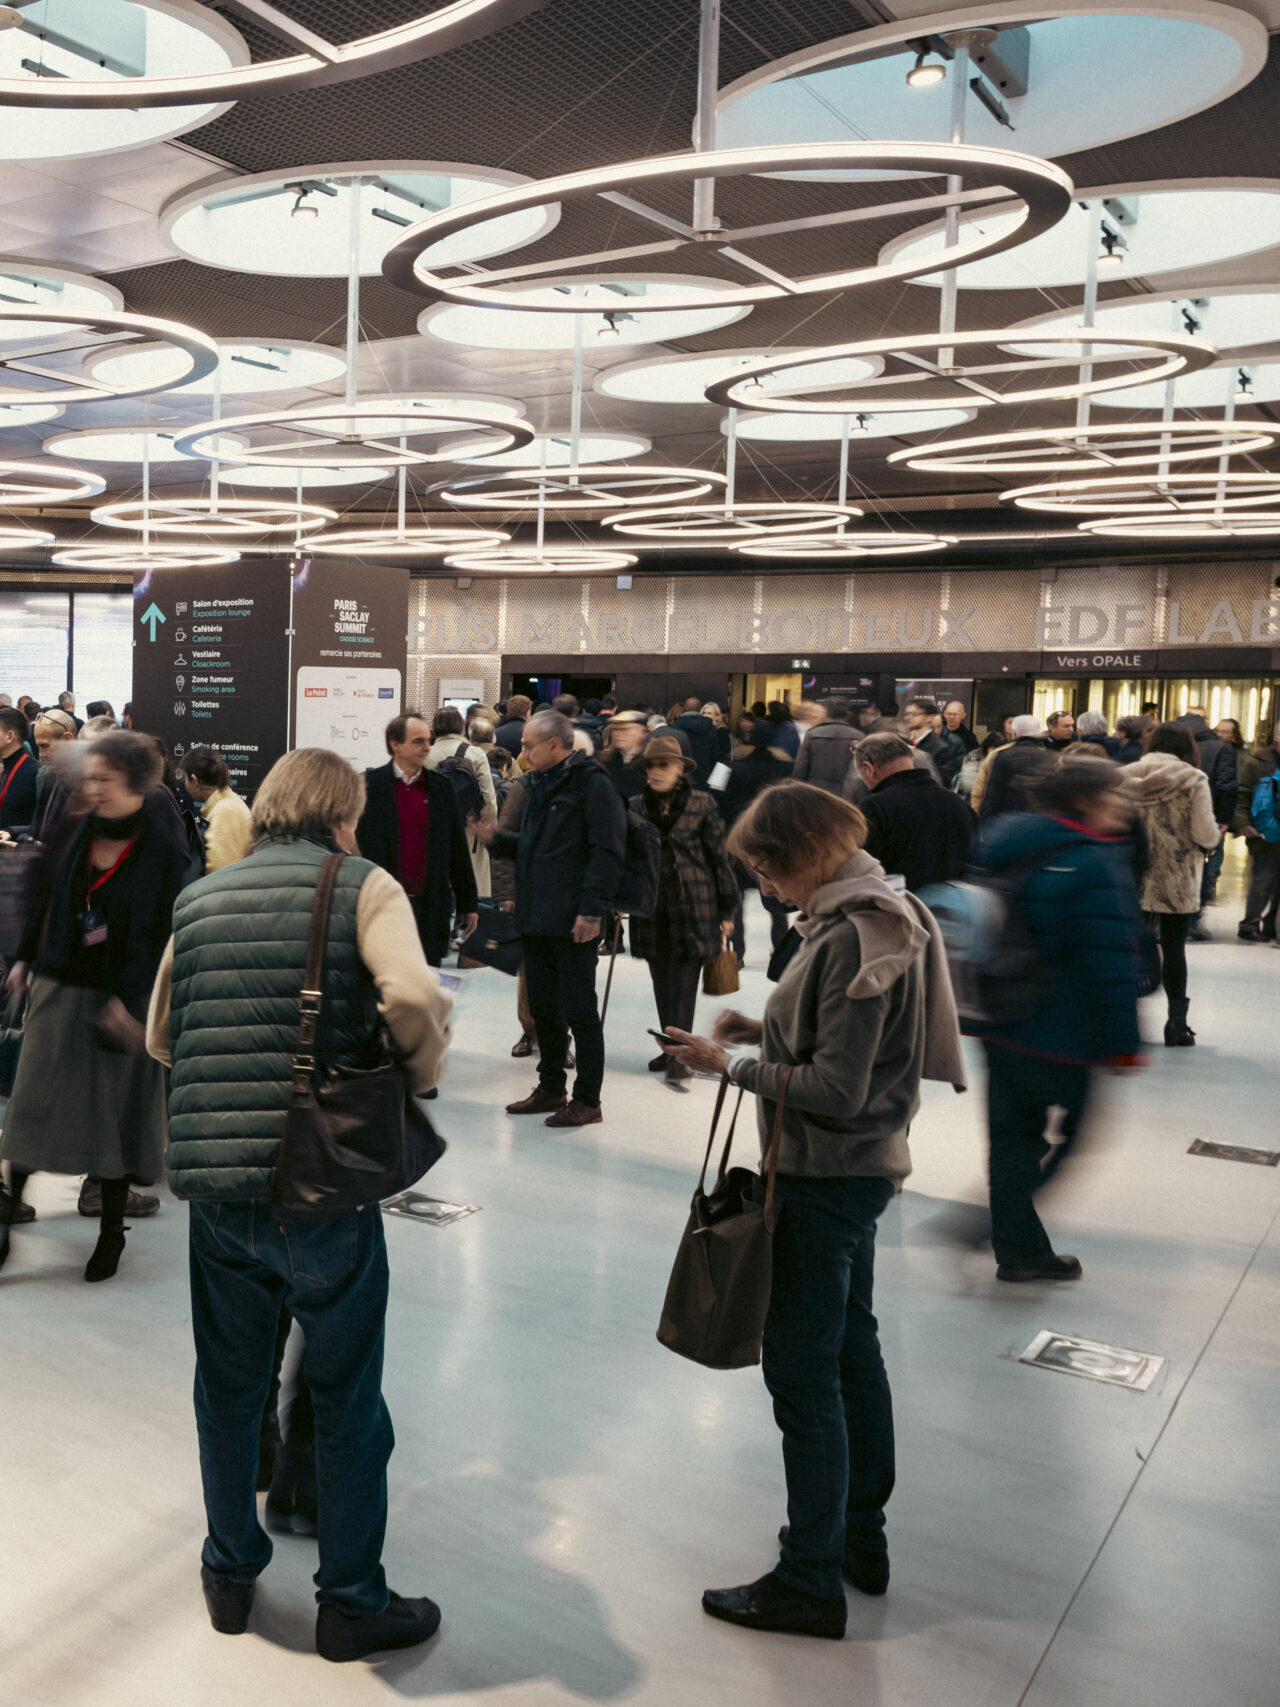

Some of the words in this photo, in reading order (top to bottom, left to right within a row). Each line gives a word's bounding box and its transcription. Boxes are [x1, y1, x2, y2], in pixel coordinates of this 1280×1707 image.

[192, 600, 211, 608] Salon
[212, 598, 254, 607] d'exposition
[334, 599, 357, 611] PARIS
[192, 609, 226, 618] Exposition
[228, 609, 251, 617] lounge
[339, 611, 370, 623] SACLAY
[192, 624, 223, 633] Cafétéria
[334, 622, 367, 634] SUMMIT
[406, 614, 497, 650] PUS
[521, 613, 720, 650] MARCEL
[739, 609, 976, 650] BOITEUX
[1035, 604, 1146, 647] EDF
[1168, 600, 1280, 643] LAB
[192, 650, 221, 658] Vestiaire
[192, 660, 231, 668] Cloackroom
[1057, 656, 1088, 667] Vers
[1092, 655, 1142, 667] OPALE
[192, 686, 220, 694] Smoking
[192, 710, 212, 718] Toilets
[211, 742, 220, 751] de
[221, 742, 259, 752] conférence
